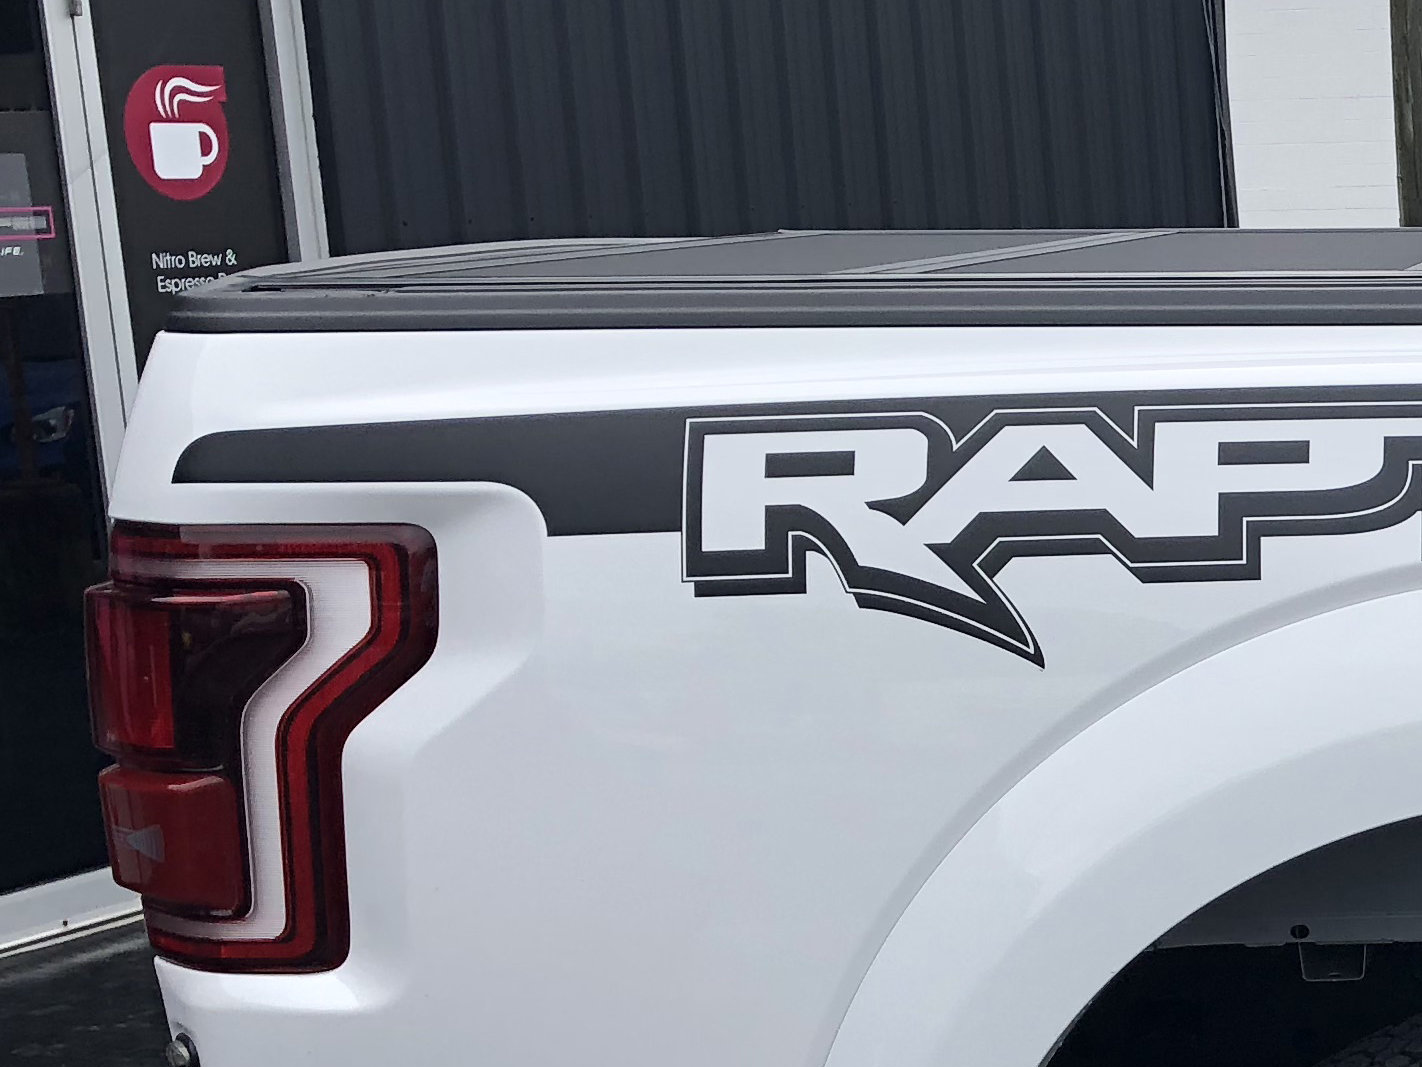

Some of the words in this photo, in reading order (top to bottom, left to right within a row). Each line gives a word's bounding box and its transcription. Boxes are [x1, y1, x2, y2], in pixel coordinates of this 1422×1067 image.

[151, 252, 186, 270] Nitro
[187, 250, 223, 268] Brew
[225, 248, 238, 266] &
